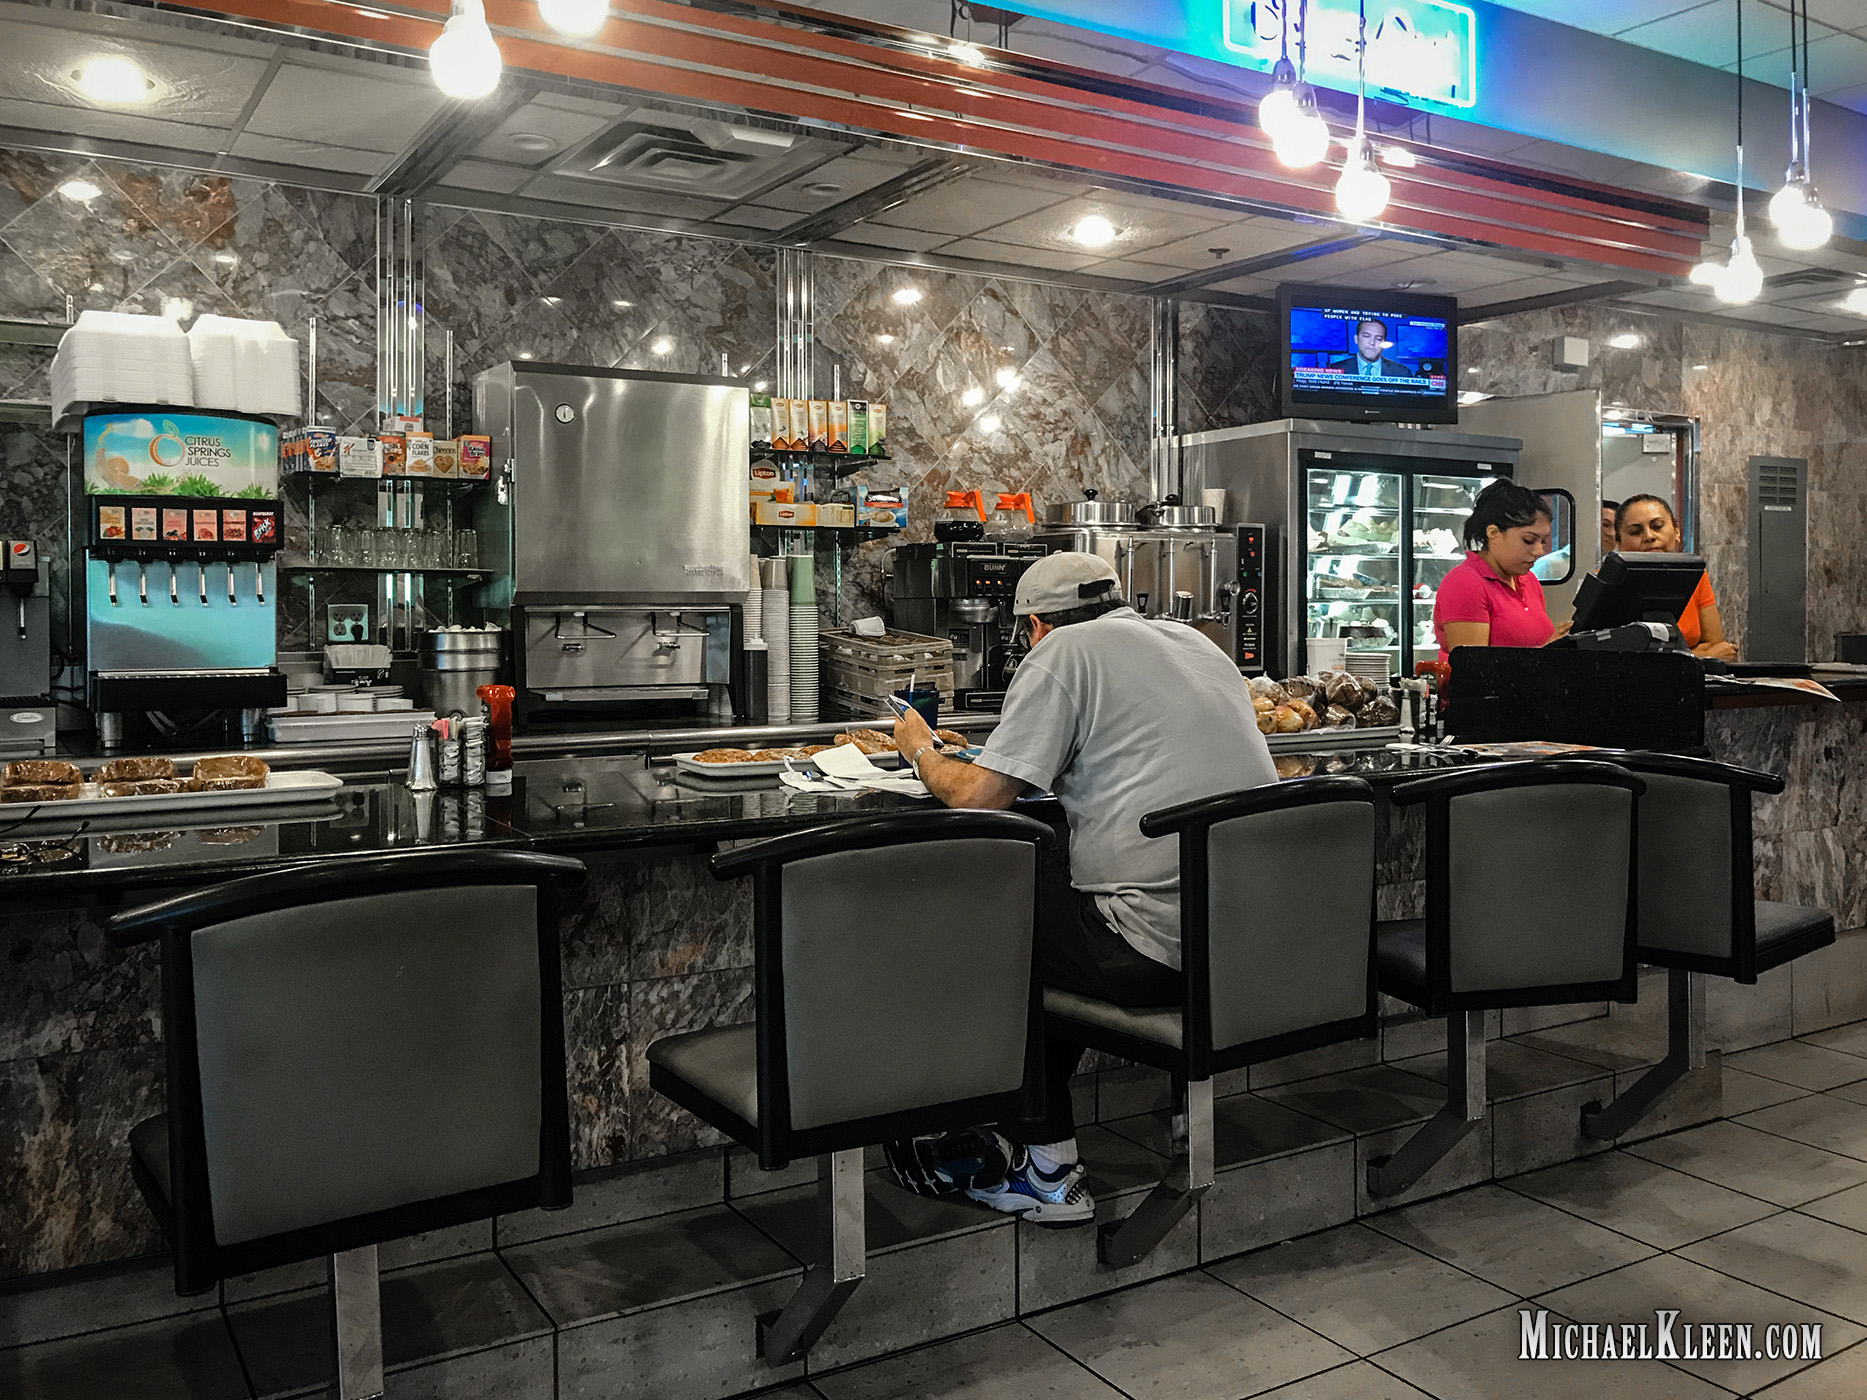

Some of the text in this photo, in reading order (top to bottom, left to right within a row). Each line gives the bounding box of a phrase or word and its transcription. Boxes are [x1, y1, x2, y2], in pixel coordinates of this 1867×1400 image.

[184, 435, 221, 447] CITRUS
[188, 446, 231, 458] SPRINGS
[184, 457, 219, 467] JUICES
